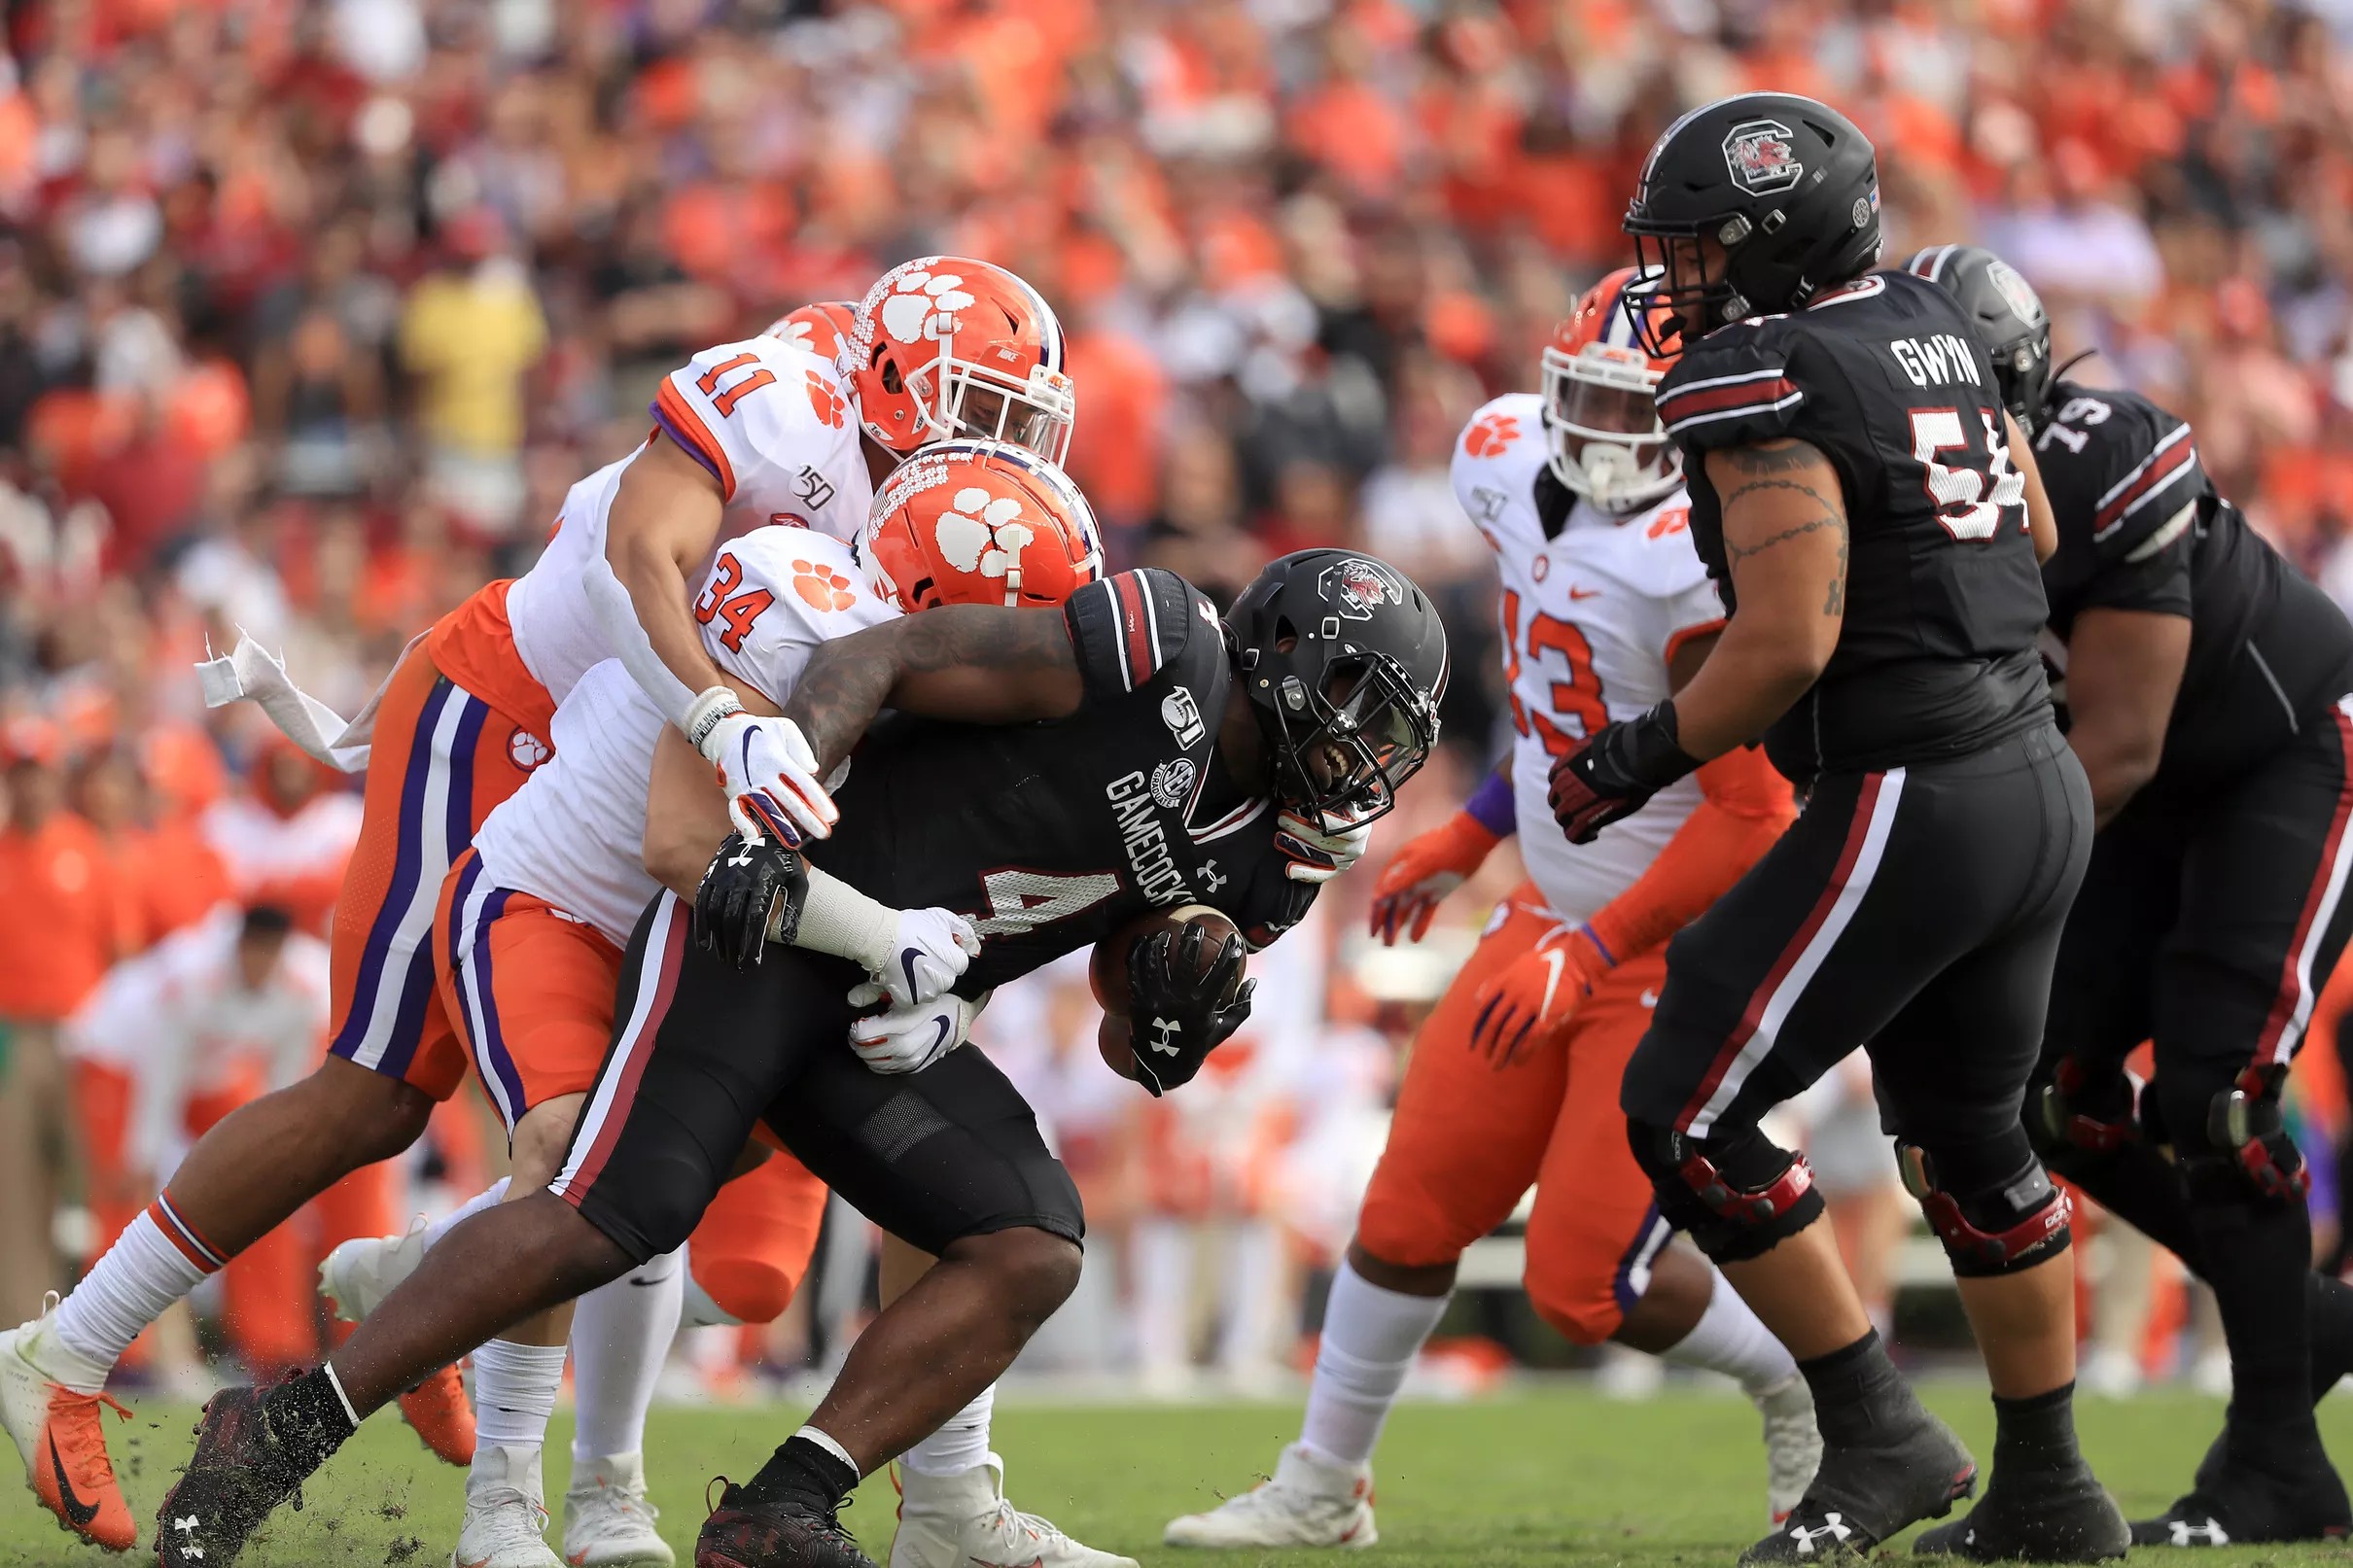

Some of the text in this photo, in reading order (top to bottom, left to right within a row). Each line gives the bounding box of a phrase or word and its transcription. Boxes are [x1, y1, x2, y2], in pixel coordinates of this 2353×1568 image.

[997, 349, 1019, 363] NIKE
[1890, 334, 1982, 387] GWYN
[695, 353, 777, 419] 11
[2036, 398, 2112, 454] 79
[790, 464, 835, 511] 150
[695, 552, 775, 655] 34
[1162, 685, 1206, 751] 150
[1151, 771, 1174, 807] GRADUATE
[1163, 761, 1194, 796] SEC
[958, 866, 1125, 942] 4
